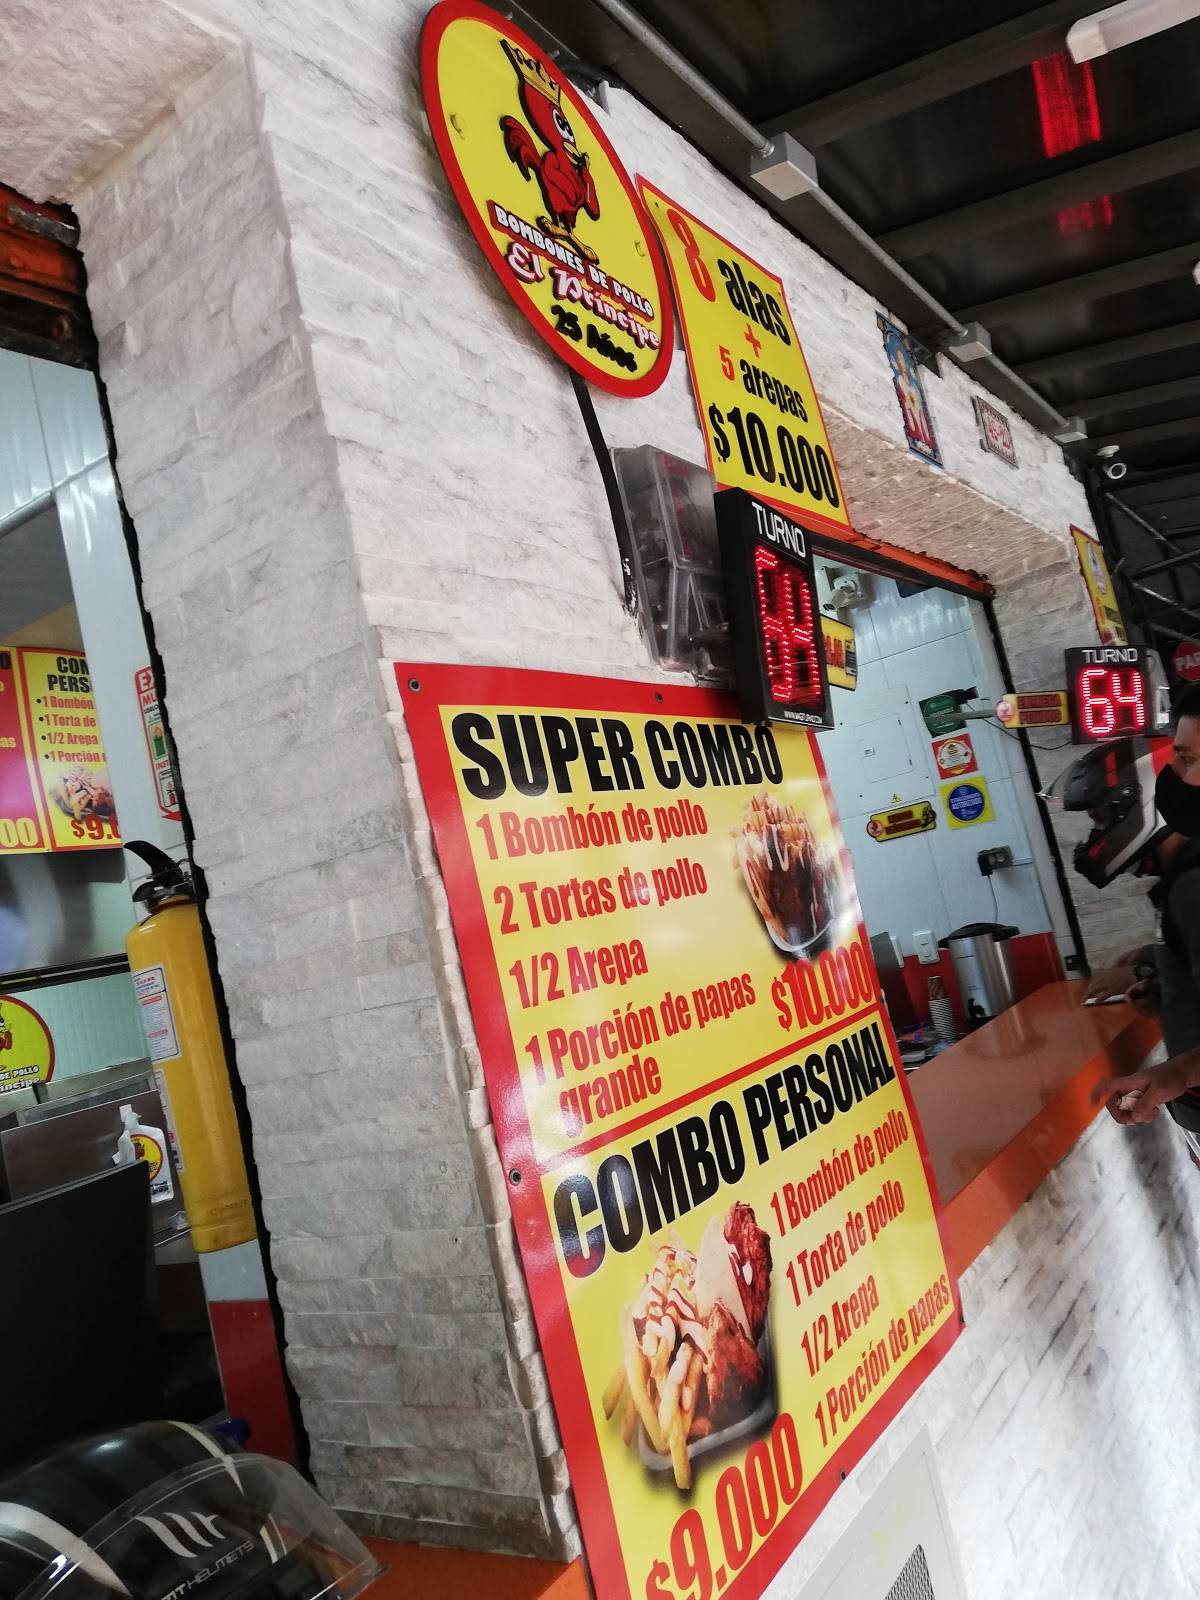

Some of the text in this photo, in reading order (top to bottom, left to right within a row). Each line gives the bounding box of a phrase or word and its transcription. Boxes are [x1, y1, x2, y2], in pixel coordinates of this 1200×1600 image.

[494, 204, 654, 319] BOMBONES DE POLLO
[507, 241, 545, 282] El
[666, 208, 716, 302] 8
[550, 304, 583, 342] 25
[717, 256, 791, 347] alas
[719, 346, 809, 424] 5 arepas
[708, 402, 840, 509] $10.000
[751, 501, 807, 559] TURNO
[1081, 647, 1138, 664] TURNO
[41, 695, 95, 709] 1 Bombón
[44, 714, 97, 728] 1 Torta de
[67, 732, 99, 746] Arepa
[1081, 668, 1145, 734] 64
[57, 750, 101, 763] Porción
[450, 711, 784, 801] SUPER COMBO
[476, 798, 708, 860] 1 Bombón de pollo
[493, 857, 708, 935] 2 Tortas de pollo
[508, 937, 649, 1012] 1/2 Arepa
[770, 942, 874, 1034] $10.000
[524, 971, 757, 1087] 1 Porción de papas
[12, 1064, 39, 1078] POLLO
[558, 1055, 662, 1140] grande
[552, 1020, 896, 1280] COMBO PERSONAL
[770, 1108, 910, 1239] 1 Bombón de pollo
[785, 1177, 906, 1308] 1 Torta de pollo
[801, 1273, 880, 1378] 1/2 Arepa
[815, 1272, 951, 1450] 1 Porción de papas
[645, 1411, 805, 1600] $9.000
